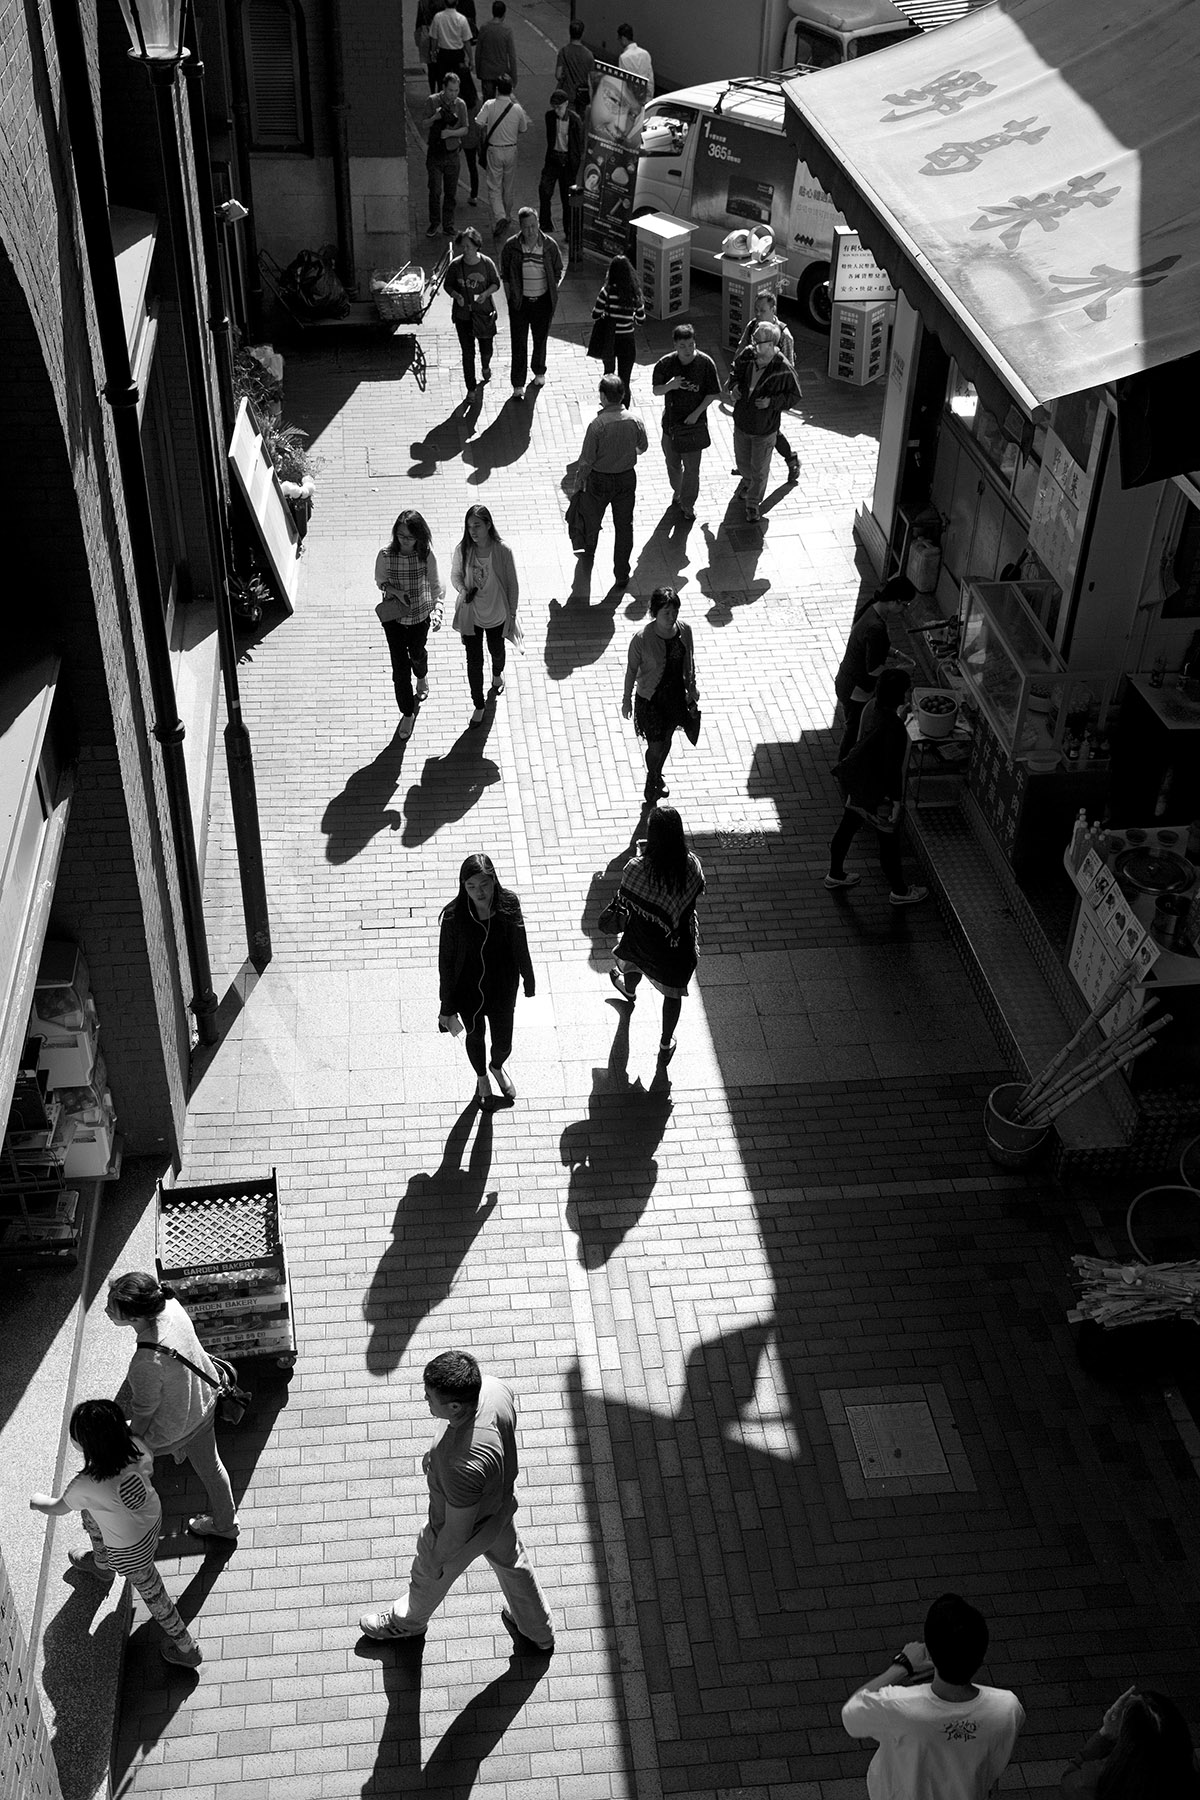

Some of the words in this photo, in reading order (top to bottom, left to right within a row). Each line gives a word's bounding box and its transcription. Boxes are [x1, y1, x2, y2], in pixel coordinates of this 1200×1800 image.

[596, 63, 646, 86] MANHATTAN
[707, 143, 727, 160] 365
[183, 1265, 219, 1276] GARDEN
[222, 1260, 256, 1270] BAKERY
[187, 1303, 222, 1313] GARDEN
[225, 1298, 258, 1308] BAKERY
